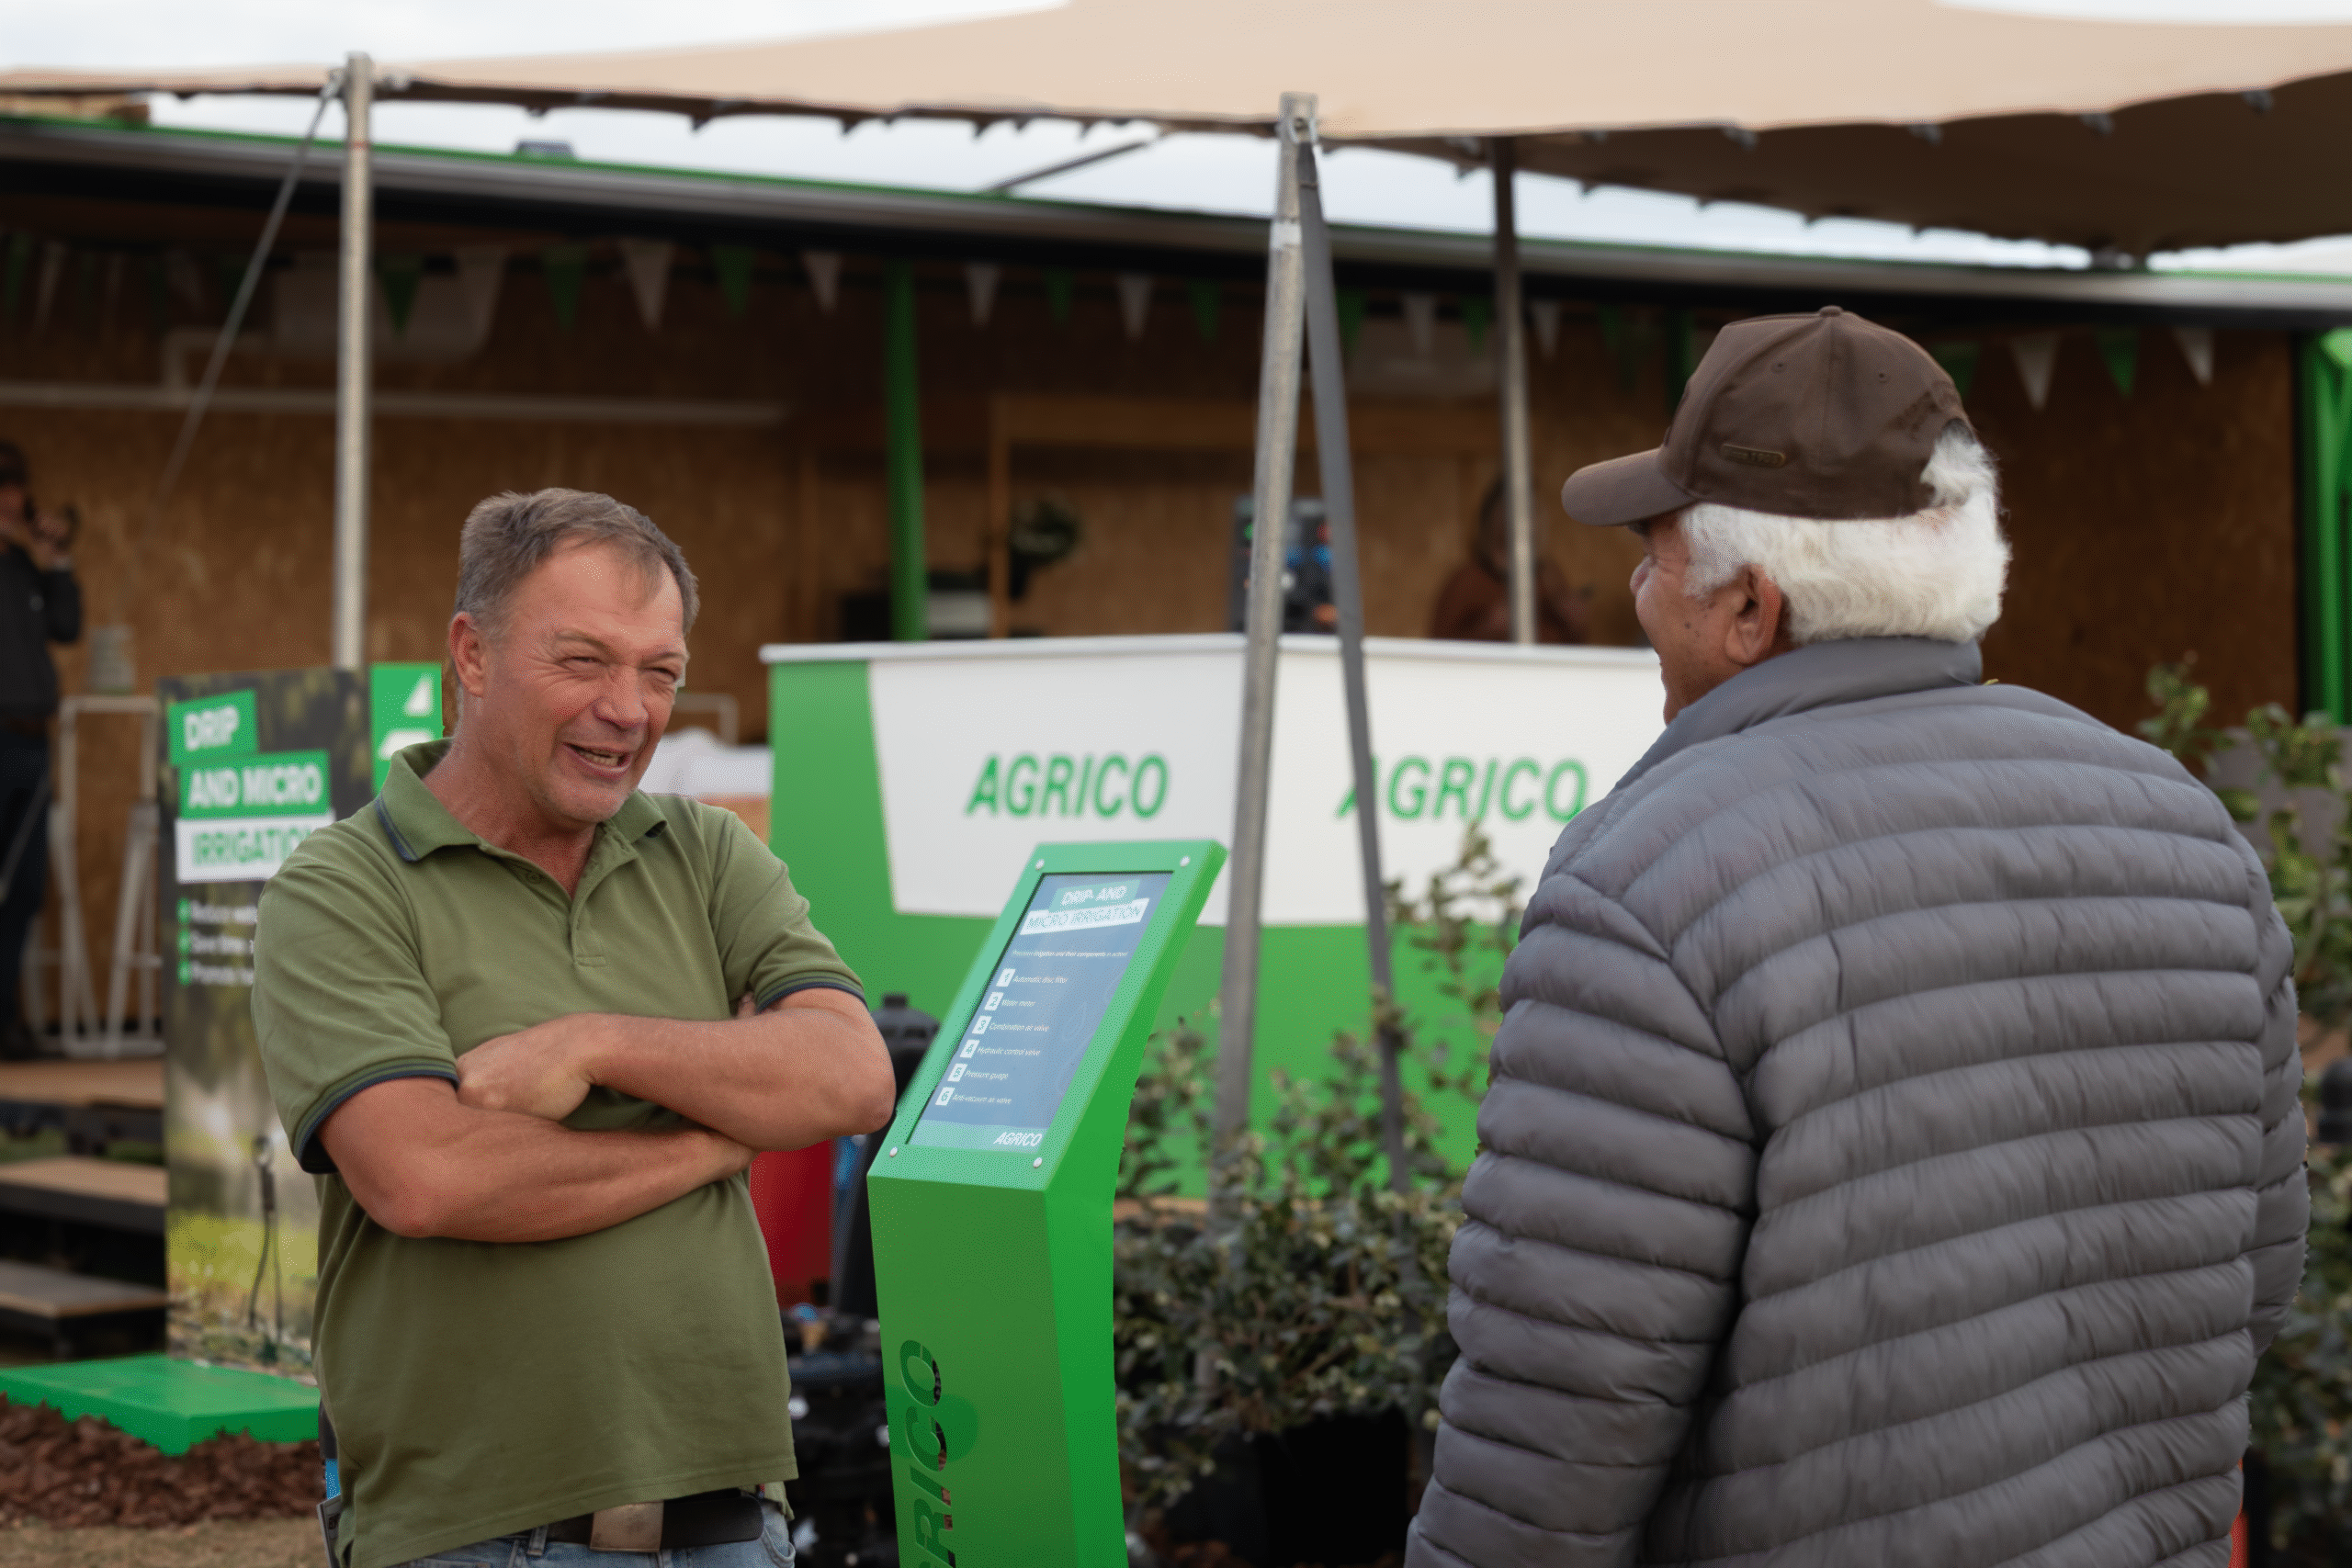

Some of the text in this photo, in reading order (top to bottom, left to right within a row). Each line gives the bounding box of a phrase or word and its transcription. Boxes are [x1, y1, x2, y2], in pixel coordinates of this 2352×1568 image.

[184, 705, 239, 750] DRIP
[188, 761, 322, 809] AND MICRO
[965, 753, 1169, 820] AGRICO
[1061, 886, 1127, 906] DRIP AND
[1027, 906, 1141, 929] MICRO IRRIGATION
[1012, 976, 1040, 984] Automatic
[989, 1022, 1024, 1032] Combination
[977, 1046, 1003, 1055] Hydraulic
[1004, 1047, 1025, 1055] control
[1025, 1048, 1041, 1056] valve
[965, 1070, 989, 1078] Pressure
[993, 1131, 1043, 1146] AGRICO
[899, 1340, 957, 1568] RICO
